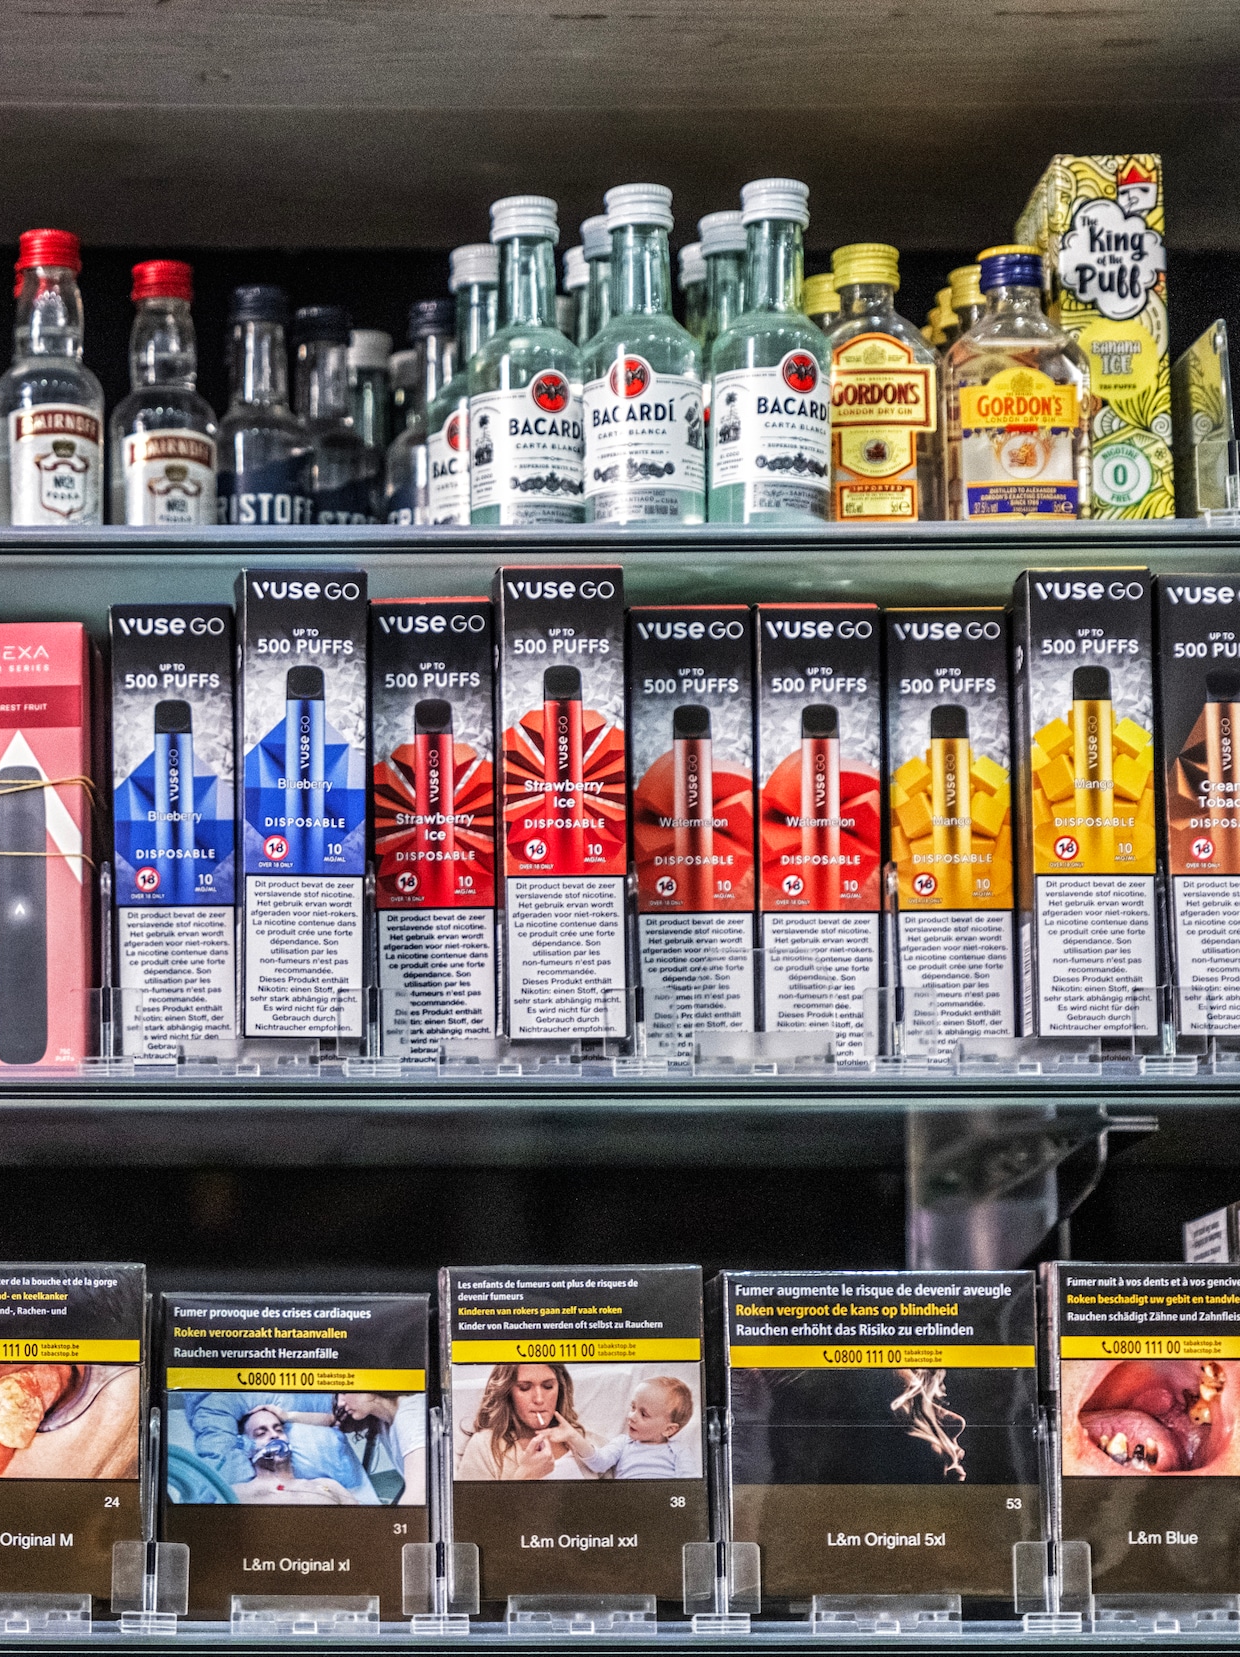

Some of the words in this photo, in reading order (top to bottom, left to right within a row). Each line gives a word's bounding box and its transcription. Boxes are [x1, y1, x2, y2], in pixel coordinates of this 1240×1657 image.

[1080, 215, 1098, 228] The
[1088, 227, 1147, 260] King
[1097, 254, 1107, 266] of
[1109, 253, 1123, 265] the
[1074, 264, 1142, 299] Puff
[1091, 339, 1142, 354] BANANA
[1101, 355, 1133, 375] ICE
[831, 381, 920, 407] GORDON'S
[838, 407, 874, 416] LONDON
[877, 407, 895, 416] DRY
[898, 407, 913, 416] GIN
[977, 395, 1063, 416] GORDON'S
[985, 416, 1019, 424] LONDON
[1023, 416, 1041, 424] DRY
[764, 421, 795, 430] CARTA
[798, 423, 827, 435] BLANCA
[515, 442, 548, 450] CARTA
[551, 444, 583, 453] BLANCA
[1113, 464, 1127, 486] 0
[1110, 492, 1134, 503] FREE
[324, 582, 359, 600] GO
[580, 581, 615, 600] GO
[1109, 582, 1143, 600] GO
[293, 628, 307, 637] UP
[309, 628, 318, 637] TO
[549, 628, 562, 637] UP
[564, 628, 574, 637] TO
[1078, 629, 1092, 637] UP
[1093, 629, 1104, 637] TO
[258, 639, 290, 654] 500
[299, 639, 353, 654] PUFFS
[514, 639, 546, 654] 500
[553, 639, 609, 654] PUFFS
[1042, 639, 1075, 654] 500
[1082, 639, 1139, 654] PUFFS
[9, 663, 49, 672] SERIES
[772, 677, 804, 692] 500
[811, 677, 867, 692] PUFFS
[24, 702, 48, 711] FRUIT
[278, 778, 333, 791] Blueberry
[525, 779, 603, 794] Strawberry
[1074, 779, 1115, 791] Mango
[553, 796, 576, 808] Ice
[265, 817, 345, 828] DISPOSABLE
[524, 818, 604, 829] DISPOSABLE
[786, 816, 855, 827] Watermelon
[1054, 817, 1135, 828] DISPOSABLE
[327, 844, 342, 855] 10
[588, 844, 602, 855] 10
[1118, 843, 1132, 854] 10
[781, 854, 861, 865] DISPOSABLE
[255, 880, 267, 889] Dit
[269, 880, 299, 890] product
[302, 880, 321, 889] bevat
[324, 880, 333, 889] de
[735, 1284, 774, 1297] Fumer
[777, 1286, 839, 1298] augmente
[842, 1284, 854, 1296] le
[856, 1284, 894, 1298] risque
[897, 1284, 912, 1296] de
[914, 1284, 961, 1296] devenir
[963, 1284, 1012, 1298] aveugle
[736, 1304, 774, 1316] Roken
[777, 1305, 830, 1318] vergroot
[832, 1304, 848, 1316] de
[851, 1304, 879, 1316] kans
[882, 1307, 898, 1318] op
[900, 1304, 958, 1316] blindheid
[736, 1324, 788, 1336] Rauchen
[791, 1324, 832, 1336] erhöht
[835, 1324, 856, 1336] das
[860, 1324, 895, 1336] Risiko
[898, 1326, 912, 1336] zu
[915, 1324, 973, 1336] erblinden
[834, 1350, 862, 1363] 0800
[866, 1350, 883, 1363] 111
[887, 1350, 901, 1363] 00
[104, 1497, 120, 1508] 24
[670, 1496, 685, 1508] 38
[1006, 1498, 1021, 1509] 53
[393, 1523, 407, 1535] 31
[0, 1532, 54, 1549] Original
[59, 1533, 73, 1546] M
[520, 1534, 554, 1548] L&m
[558, 1534, 613, 1551] Original
[617, 1534, 638, 1548] xxl
[827, 1533, 860, 1547] L&m
[864, 1533, 920, 1550] Original
[924, 1533, 945, 1547] 5xl
[1128, 1531, 1161, 1545] L&m
[1165, 1531, 1198, 1545] Blue
[243, 1558, 275, 1572] L&m
[279, 1558, 333, 1575] Original
[338, 1558, 350, 1571] xl
